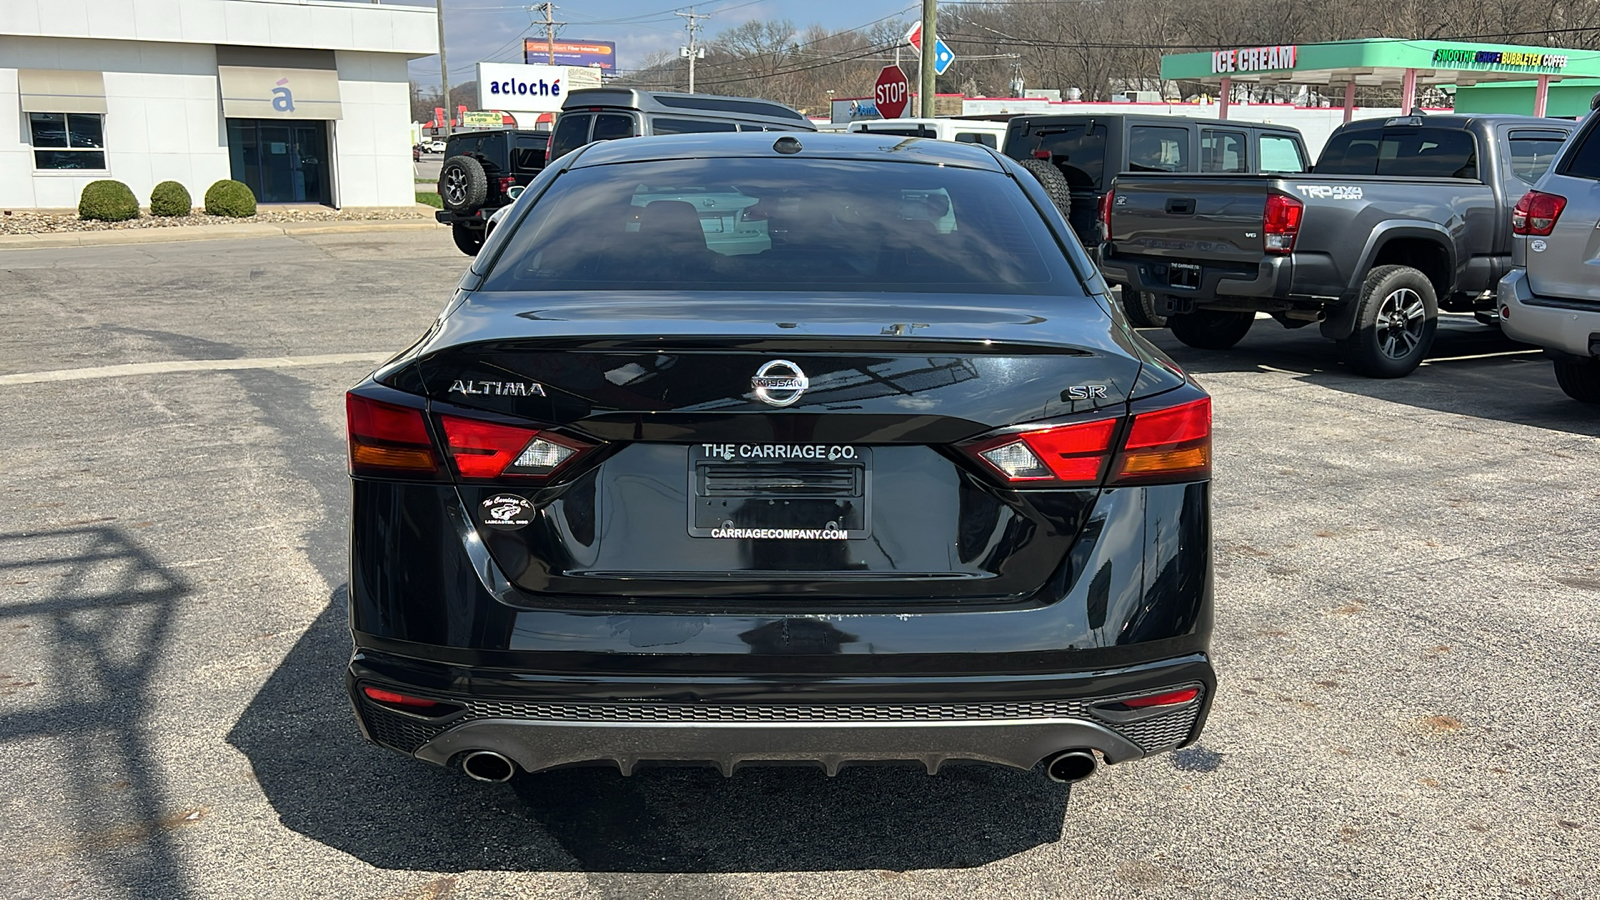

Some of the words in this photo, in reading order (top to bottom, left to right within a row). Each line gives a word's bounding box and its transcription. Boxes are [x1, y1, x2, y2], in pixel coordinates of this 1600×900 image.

[1212, 50, 1237, 73] ICE
[1238, 46, 1297, 71] CREAM
[1436, 49, 1476, 62] SMOOTHIE
[1542, 54, 1568, 68] COFFEE
[491, 78, 560, 96] acloché
[877, 81, 906, 105] STOP
[272, 78, 295, 113] á
[1296, 185, 1333, 198] TRD
[448, 380, 547, 397] ALTIMA
[757, 378, 804, 388] NISSAN
[1069, 385, 1107, 399] SR
[702, 444, 736, 457] THE
[740, 444, 826, 458] CARRIAGE
[830, 445, 858, 459] CO.
[482, 498, 493, 508] The
[494, 496, 519, 505] Carriage
[711, 528, 848, 540] CARRIAGECOMPANY.COM
